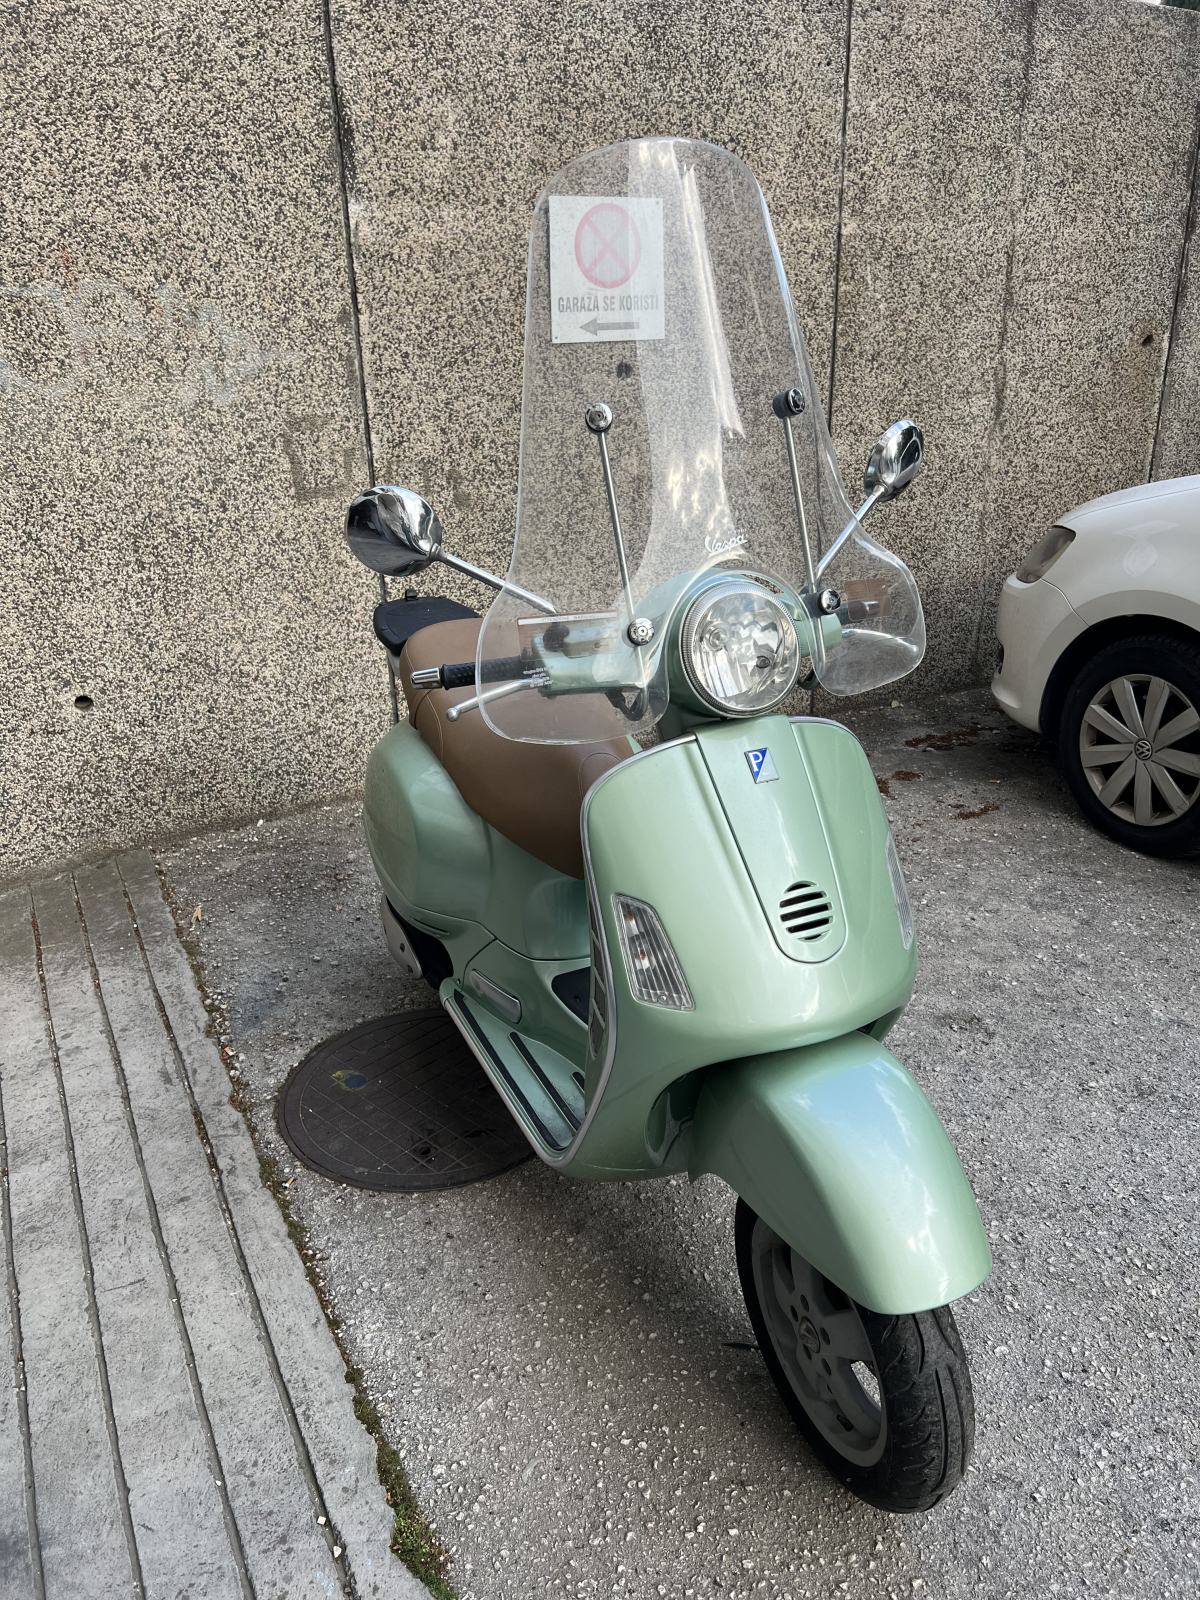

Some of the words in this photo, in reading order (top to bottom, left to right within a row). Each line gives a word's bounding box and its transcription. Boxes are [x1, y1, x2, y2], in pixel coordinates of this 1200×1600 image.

[602, 295, 616, 312] SE
[619, 294, 659, 311] KORISTI
[748, 751, 763, 772] P
